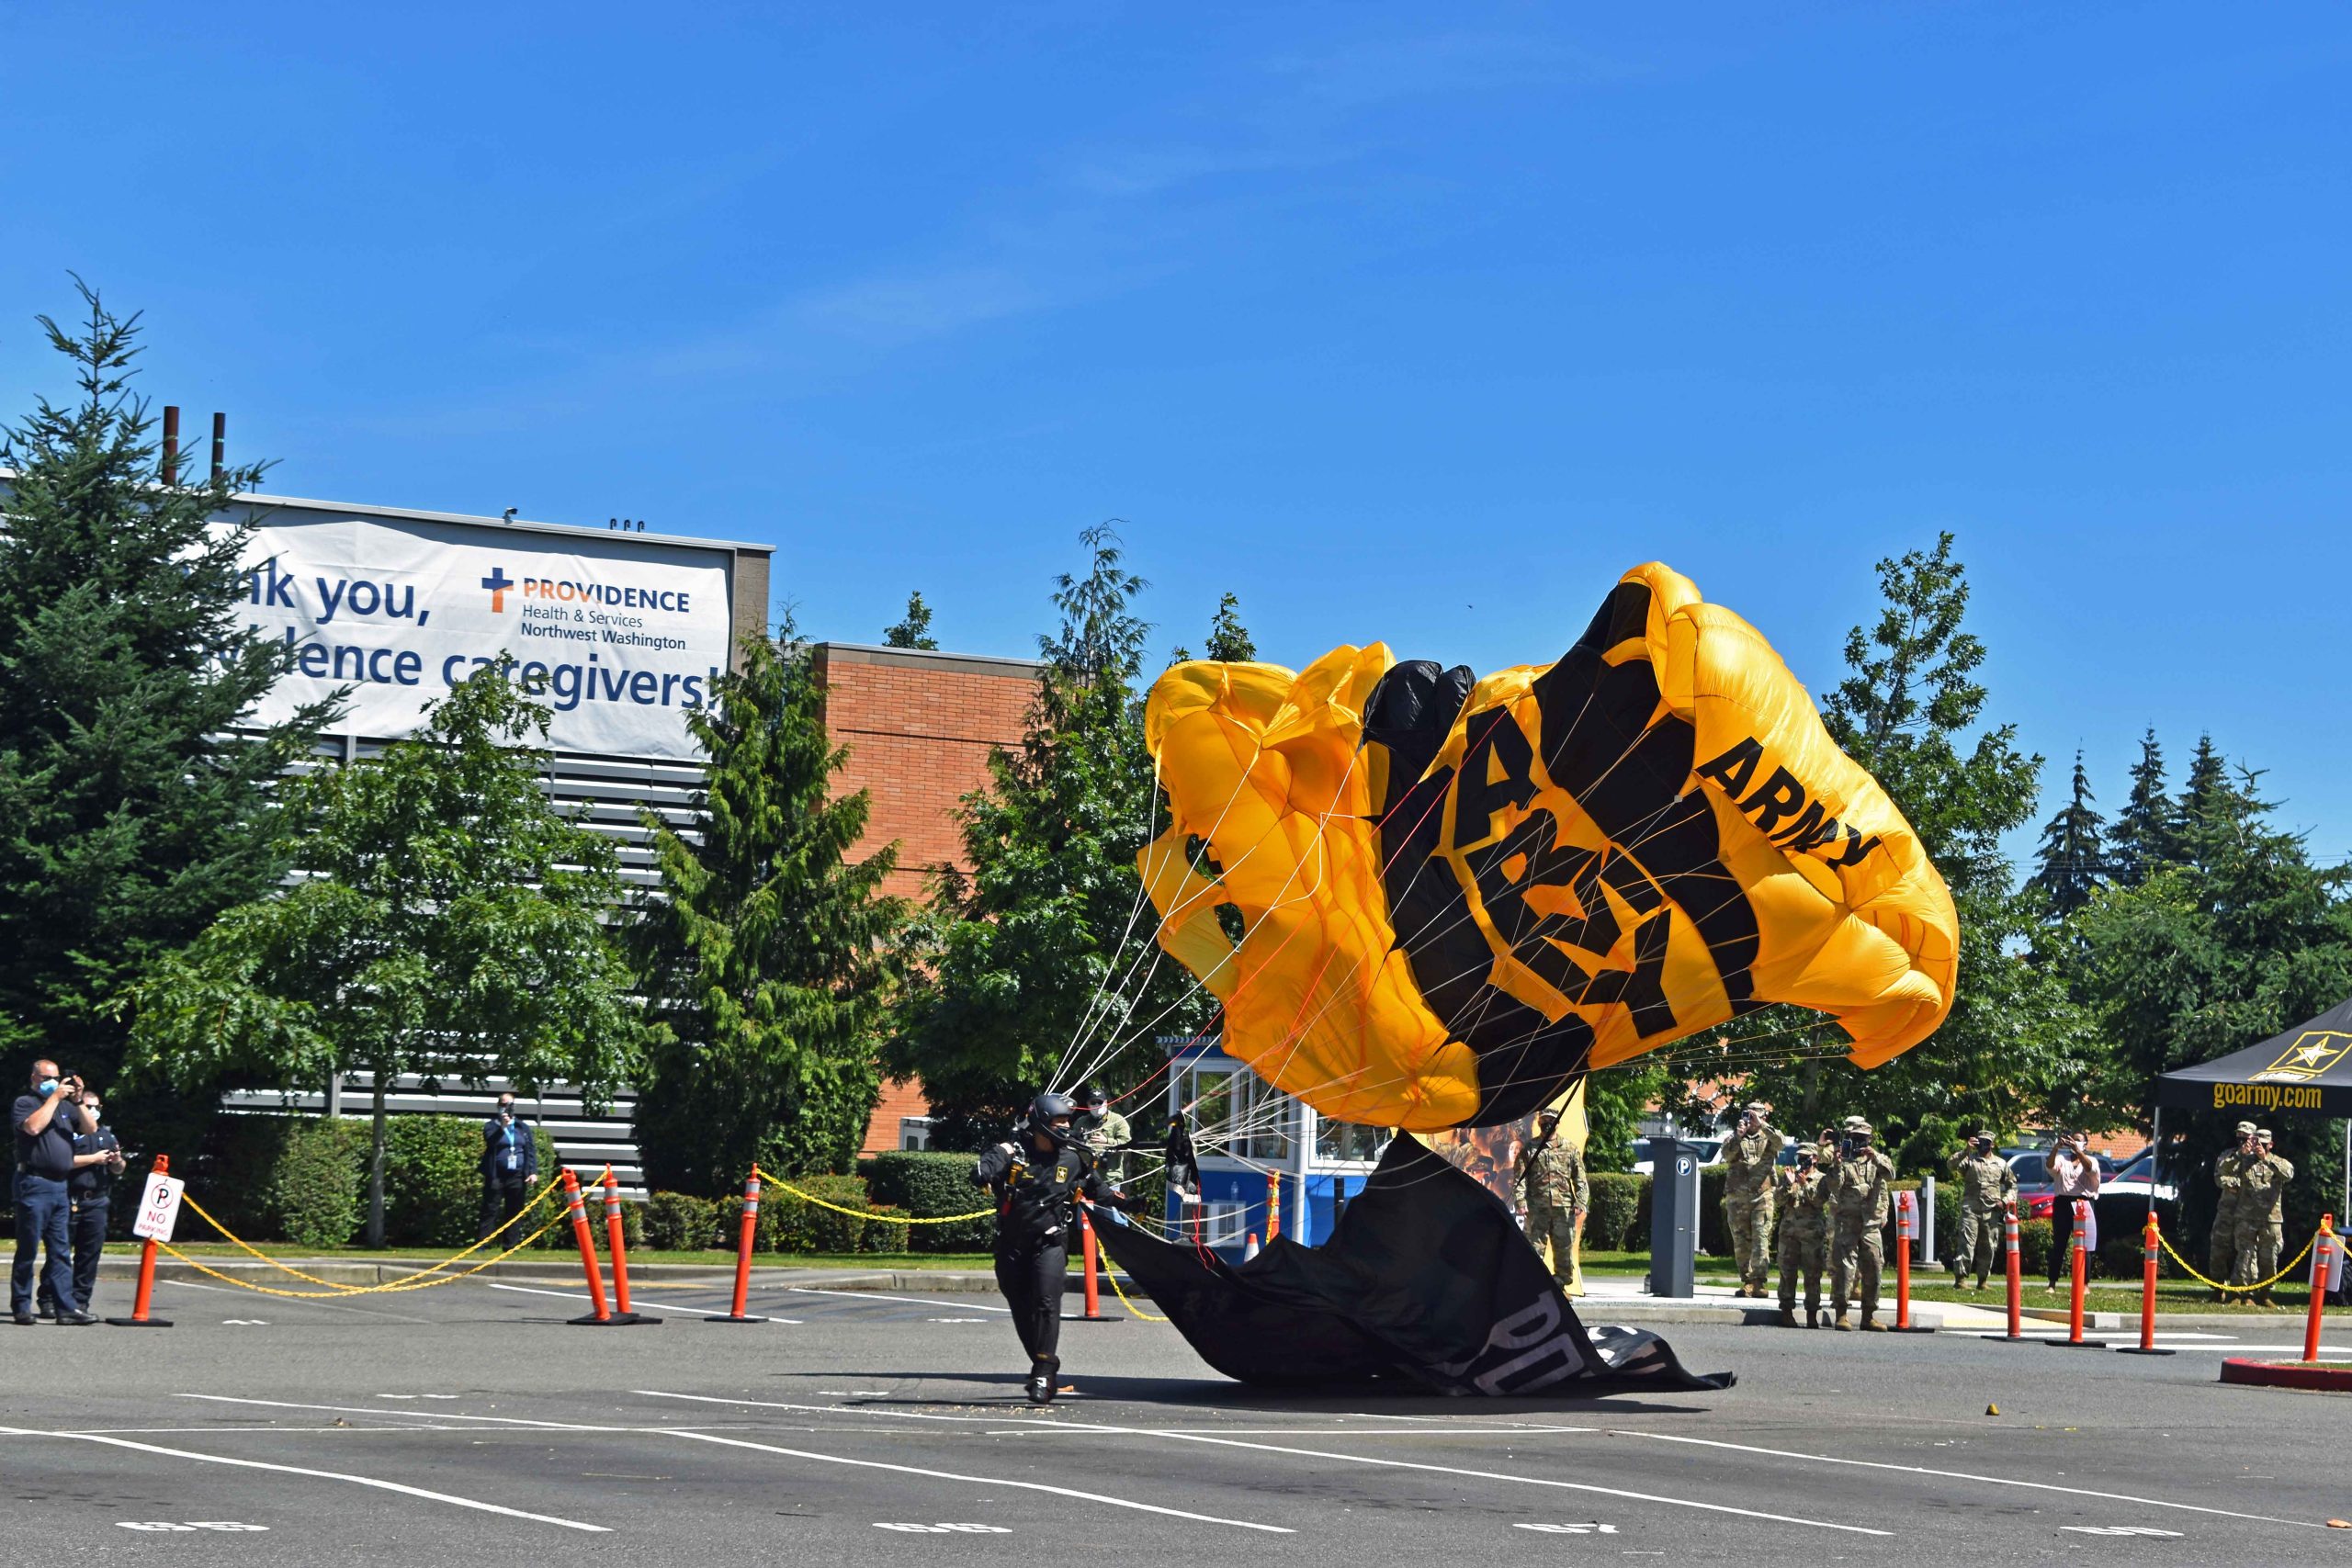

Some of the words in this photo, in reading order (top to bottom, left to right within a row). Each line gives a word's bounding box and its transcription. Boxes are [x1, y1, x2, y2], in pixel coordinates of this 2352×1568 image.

[315, 577, 431, 626] you,
[524, 578, 690, 613] PROVIDENCE
[523, 604, 568, 621] Health
[573, 609, 584, 623] &
[589, 611, 643, 628] Services
[521, 622, 597, 642] Northwest
[602, 629, 686, 650] Washington
[1693, 736, 1882, 872] ARMY
[2213, 1082, 2322, 1111] goarmy.com
[147, 1211, 166, 1224] NO
